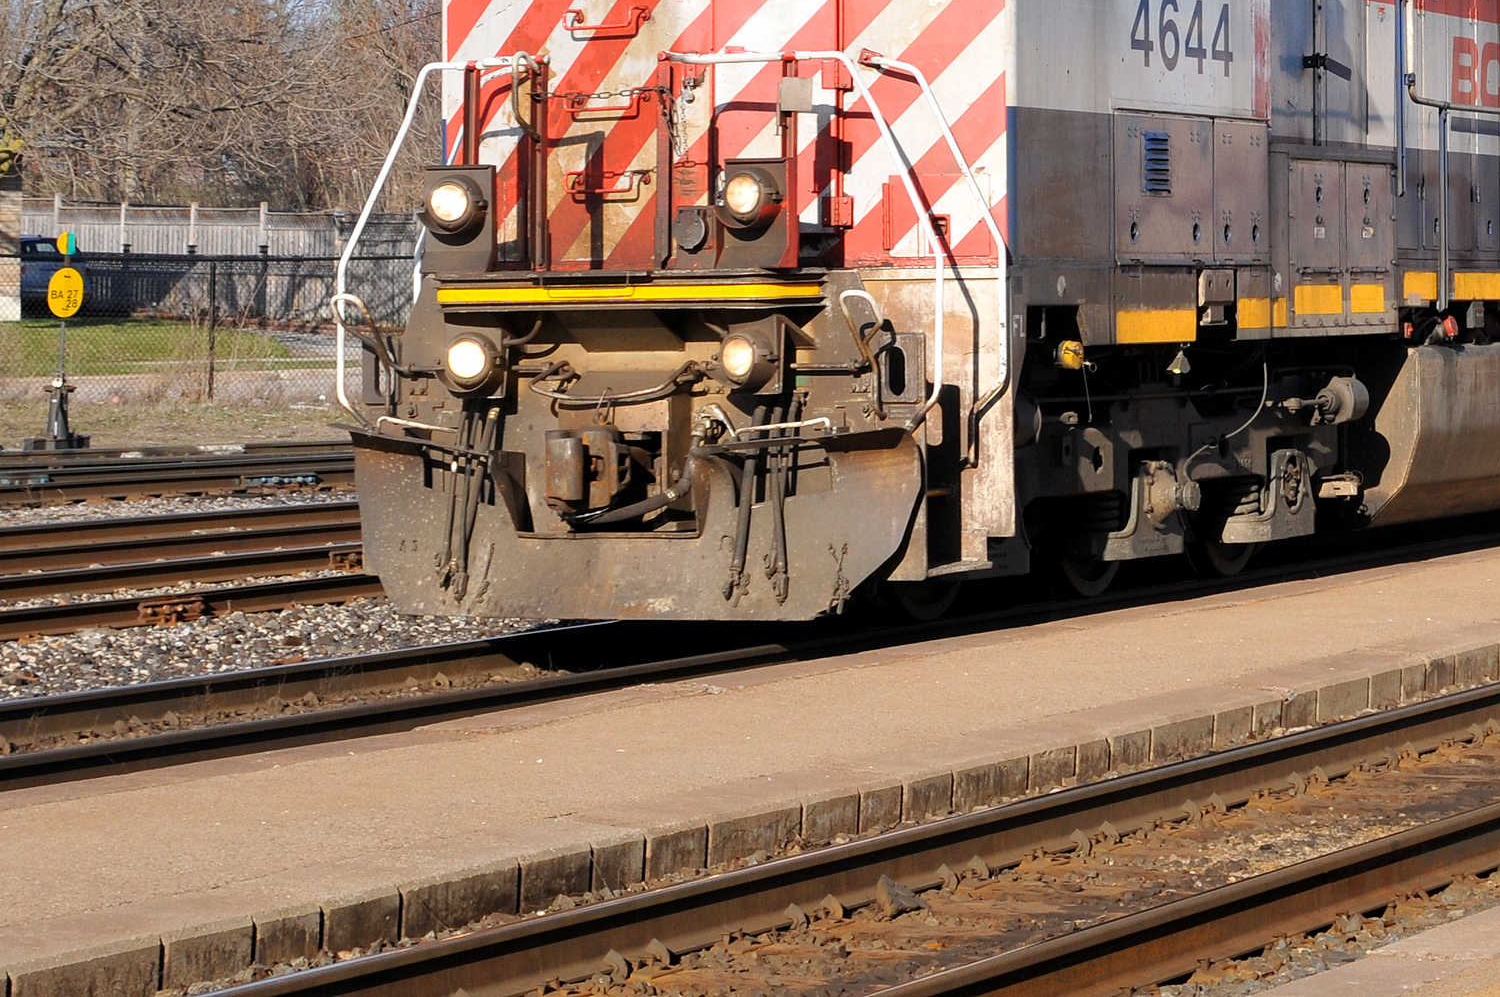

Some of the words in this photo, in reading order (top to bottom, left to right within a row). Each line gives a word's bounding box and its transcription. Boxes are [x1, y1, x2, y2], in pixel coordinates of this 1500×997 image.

[51, 290, 63, 299] BA
[67, 290, 78, 299] 27
[66, 299, 78, 308] 28
